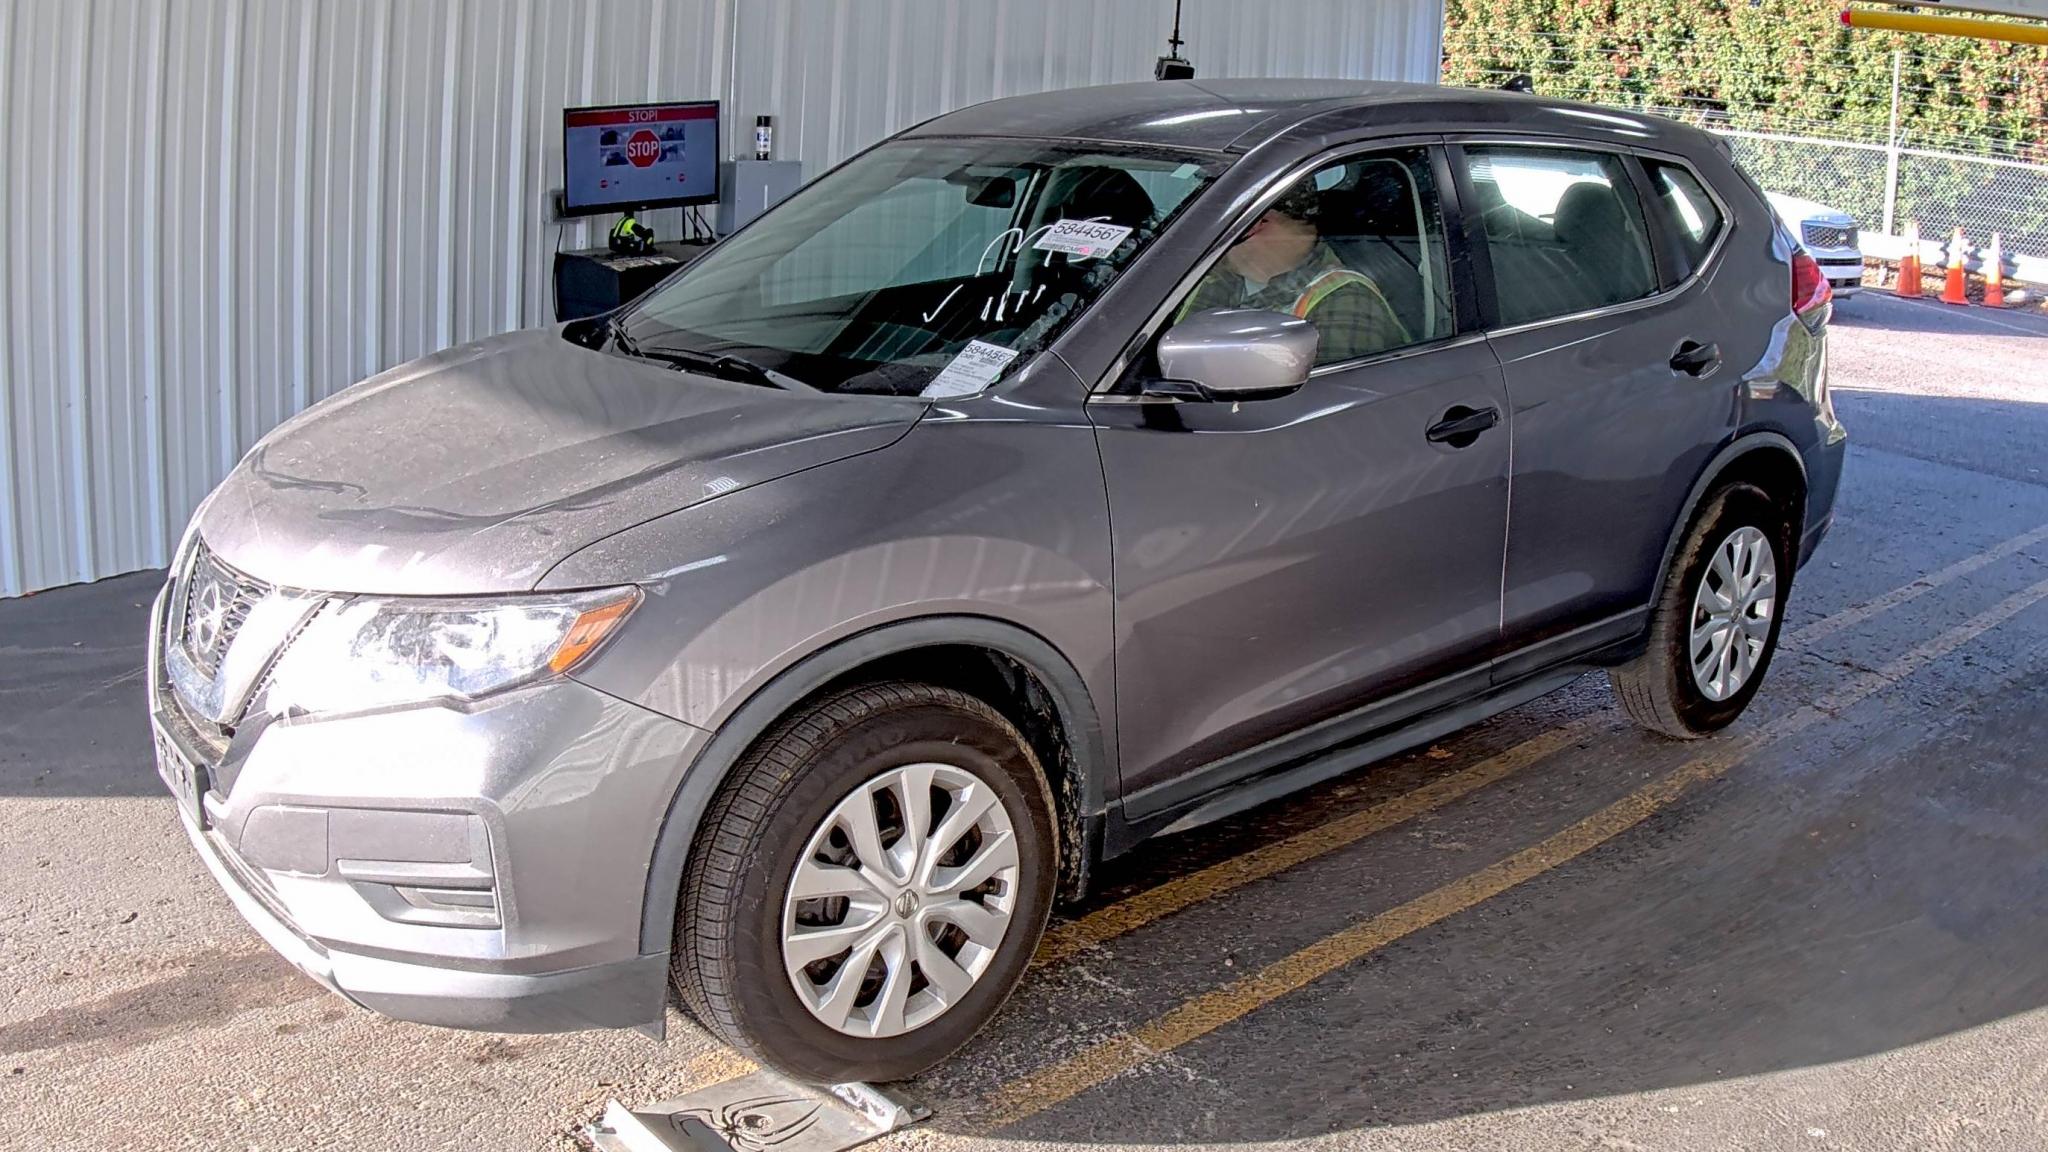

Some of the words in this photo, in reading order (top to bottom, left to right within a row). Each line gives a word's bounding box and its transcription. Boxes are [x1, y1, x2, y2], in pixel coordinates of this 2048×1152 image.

[628, 141, 659, 158] STOP
[1053, 222, 1126, 241] 5844567
[964, 344, 1015, 367] 5844567
